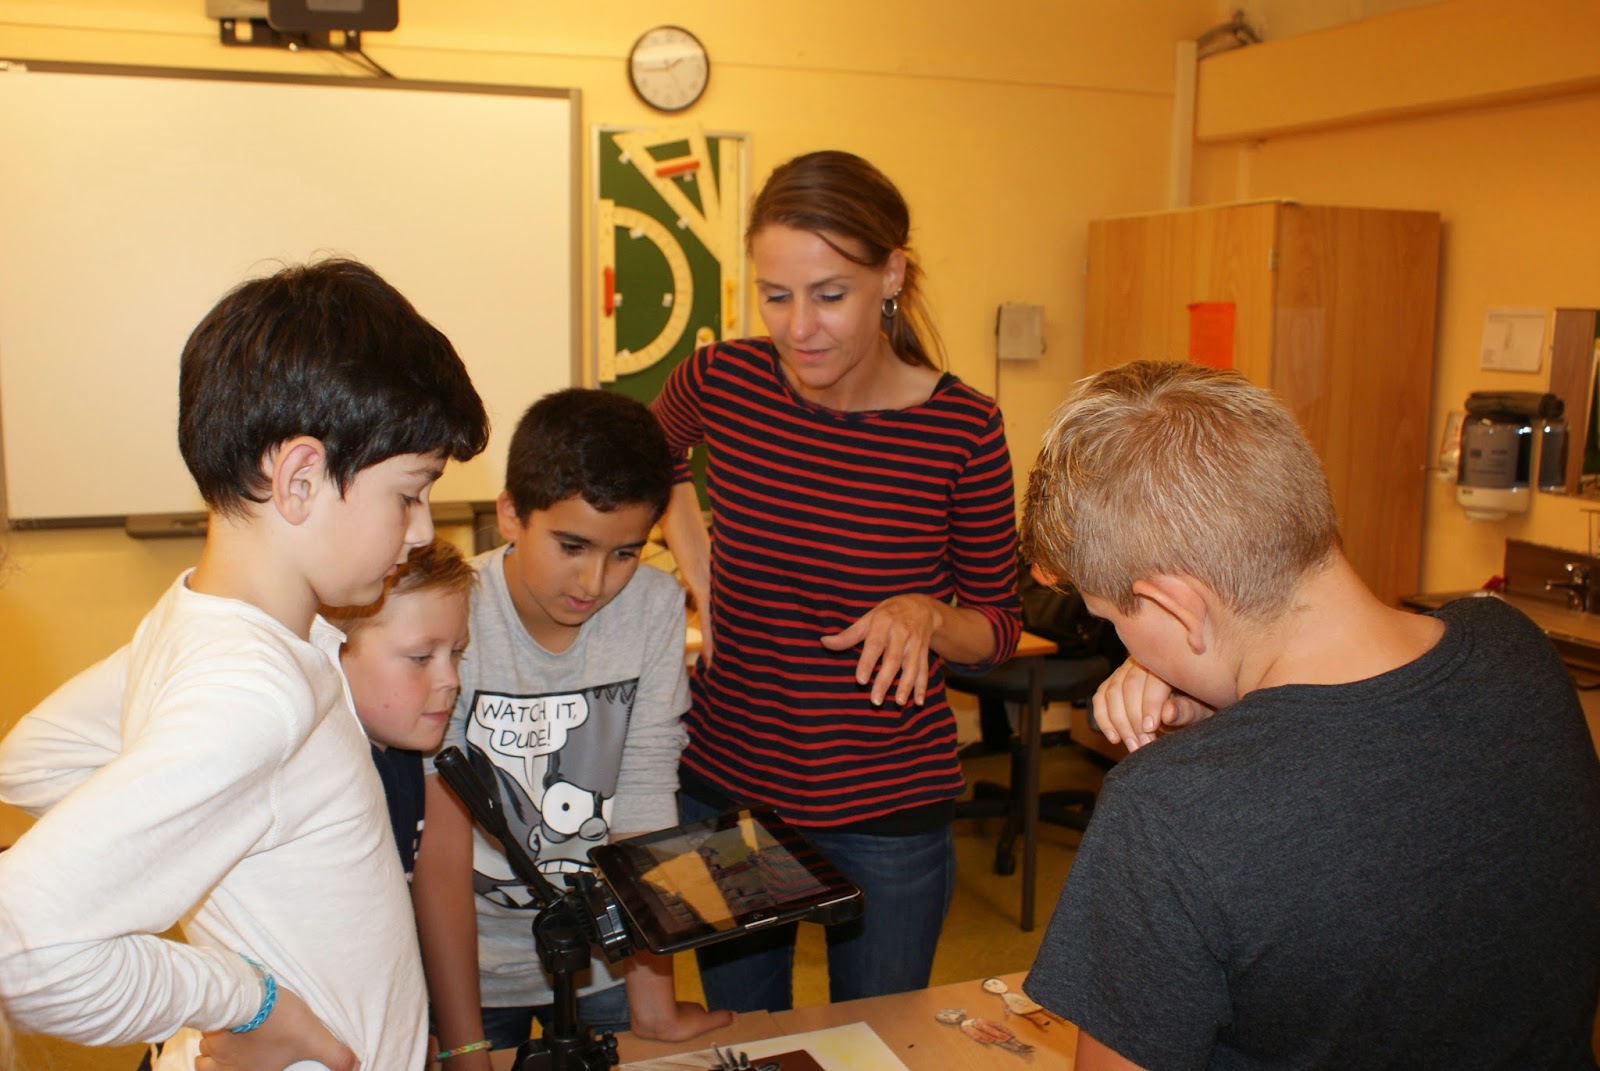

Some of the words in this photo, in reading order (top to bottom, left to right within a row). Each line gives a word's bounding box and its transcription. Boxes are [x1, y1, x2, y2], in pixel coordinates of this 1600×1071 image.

[481, 700, 547, 722] WATCH
[556, 702, 577, 720] IT,
[500, 721, 551, 748] DUDE!
